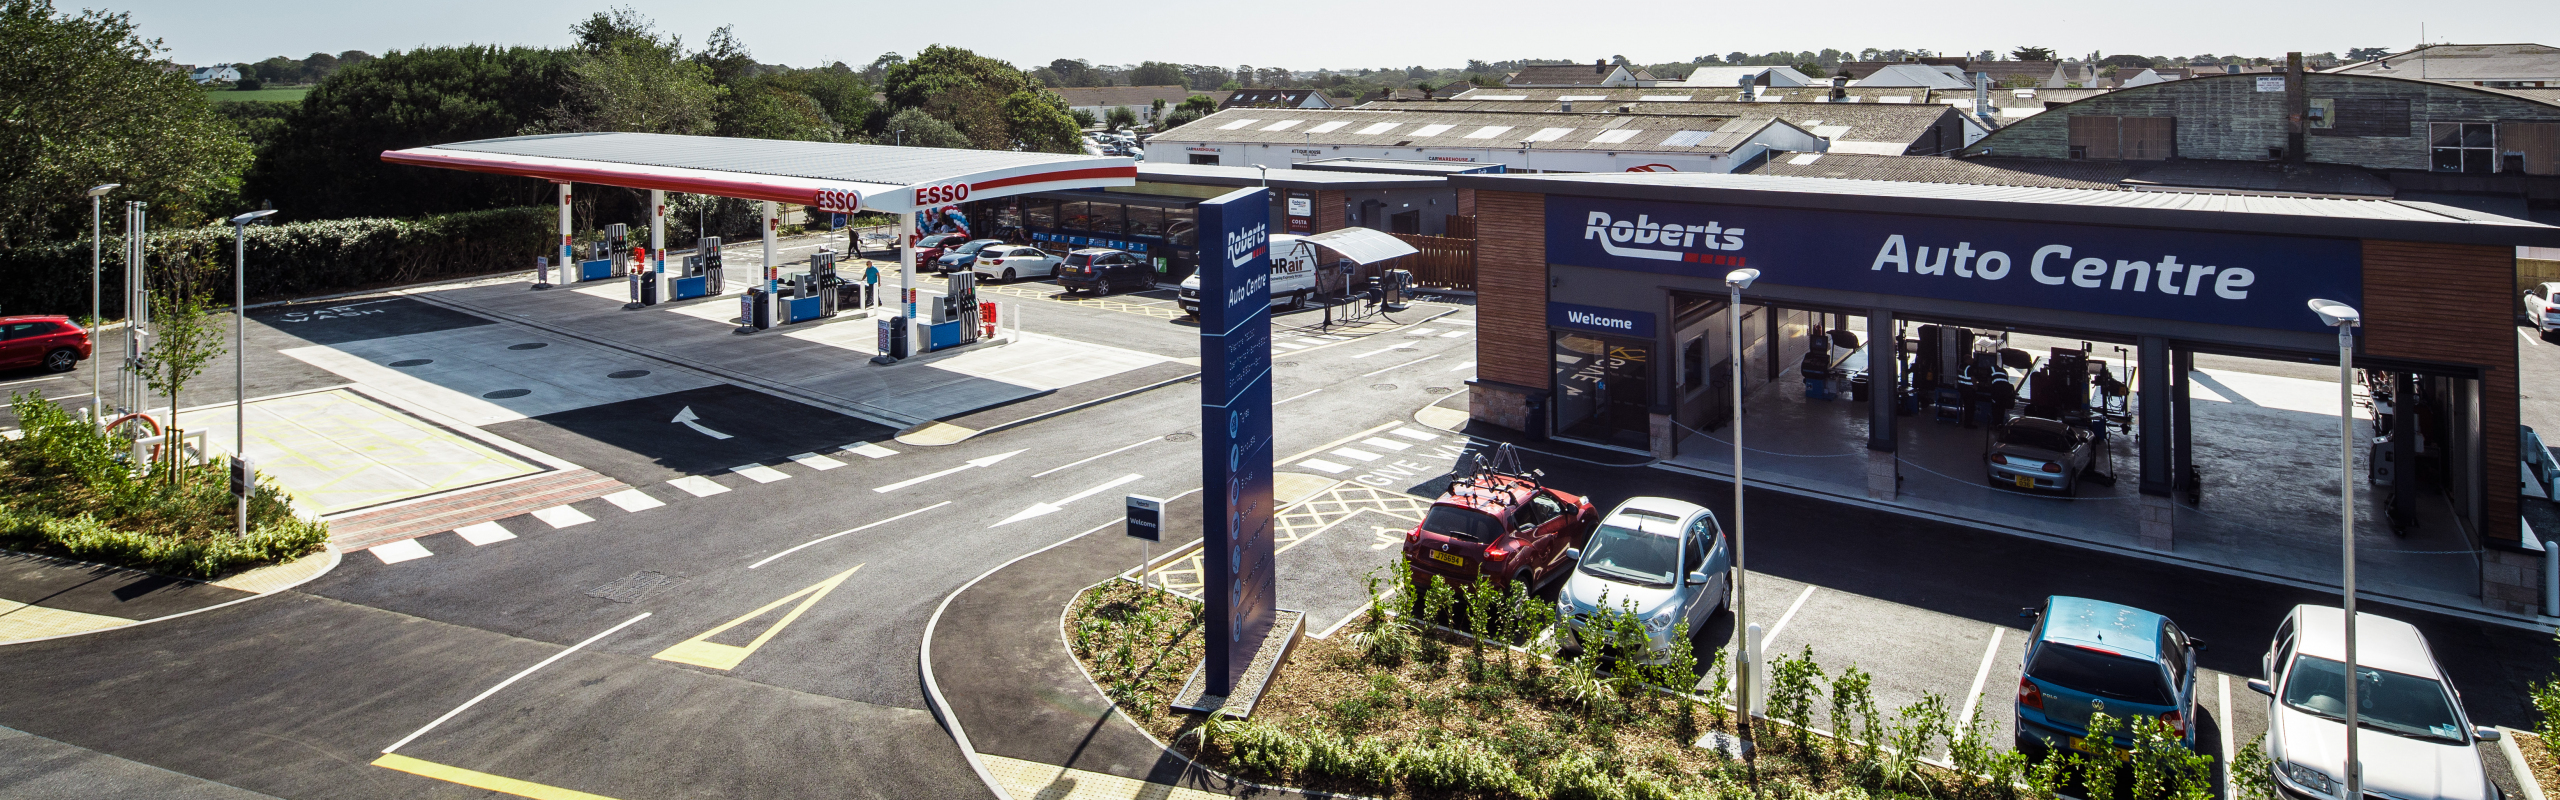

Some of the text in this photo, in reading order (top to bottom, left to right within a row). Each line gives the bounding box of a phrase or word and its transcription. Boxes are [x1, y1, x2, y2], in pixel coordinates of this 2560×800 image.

[818, 189, 858, 211] ESSO
[916, 183, 969, 206] ESSO
[1227, 222, 1266, 267] Roberts
[1584, 210, 1746, 261] Roberts
[1871, 233, 2255, 300] Auto Centre
[1228, 273, 1266, 308] Auto Centre
[281, 309, 385, 323] WASH
[285, 306, 355, 317] CAR
[1567, 310, 1633, 330] Welcome
[1354, 437, 1490, 486] GIVE WAY
[1130, 517, 1156, 529] Welcome
[2042, 692, 2058, 700] POLO
